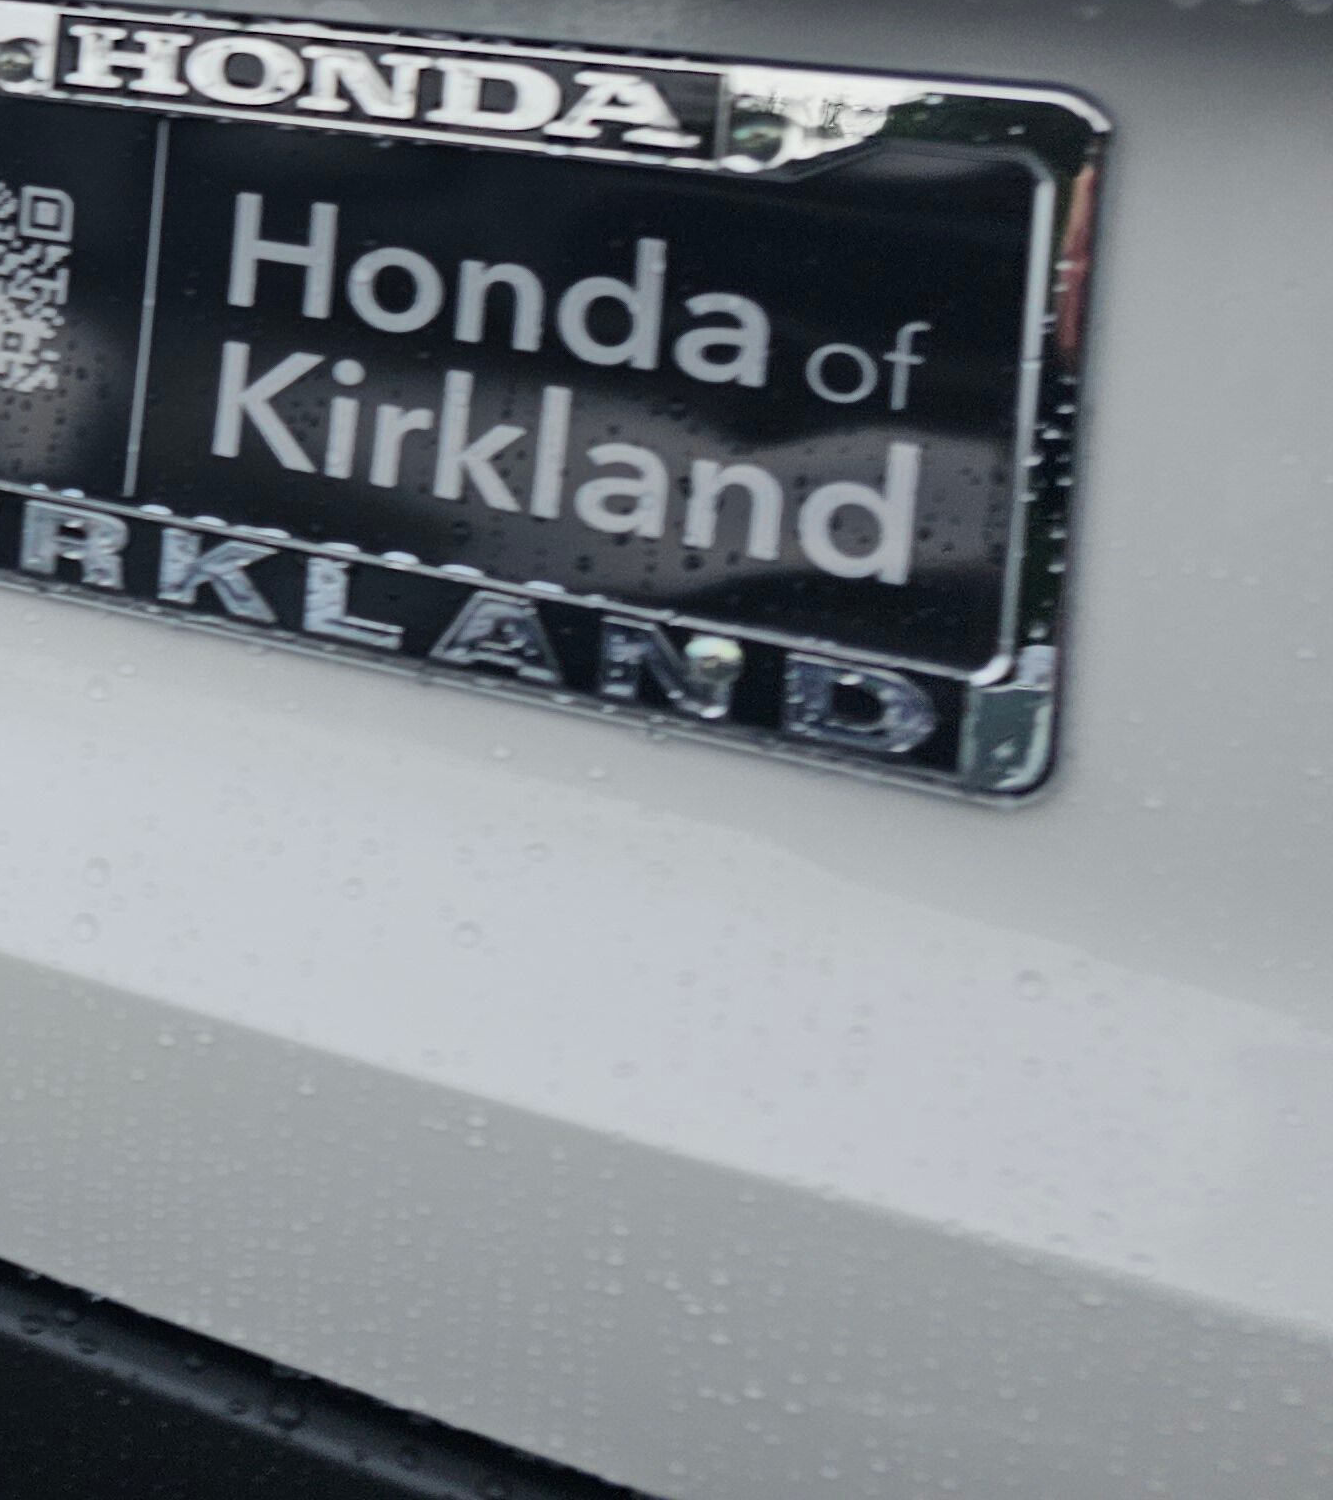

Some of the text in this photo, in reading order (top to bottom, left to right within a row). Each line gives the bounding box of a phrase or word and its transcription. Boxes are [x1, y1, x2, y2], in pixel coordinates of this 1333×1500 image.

[66, 23, 701, 150] HONDA
[226, 190, 932, 411] Honda of
[210, 339, 922, 586] Kirkland
